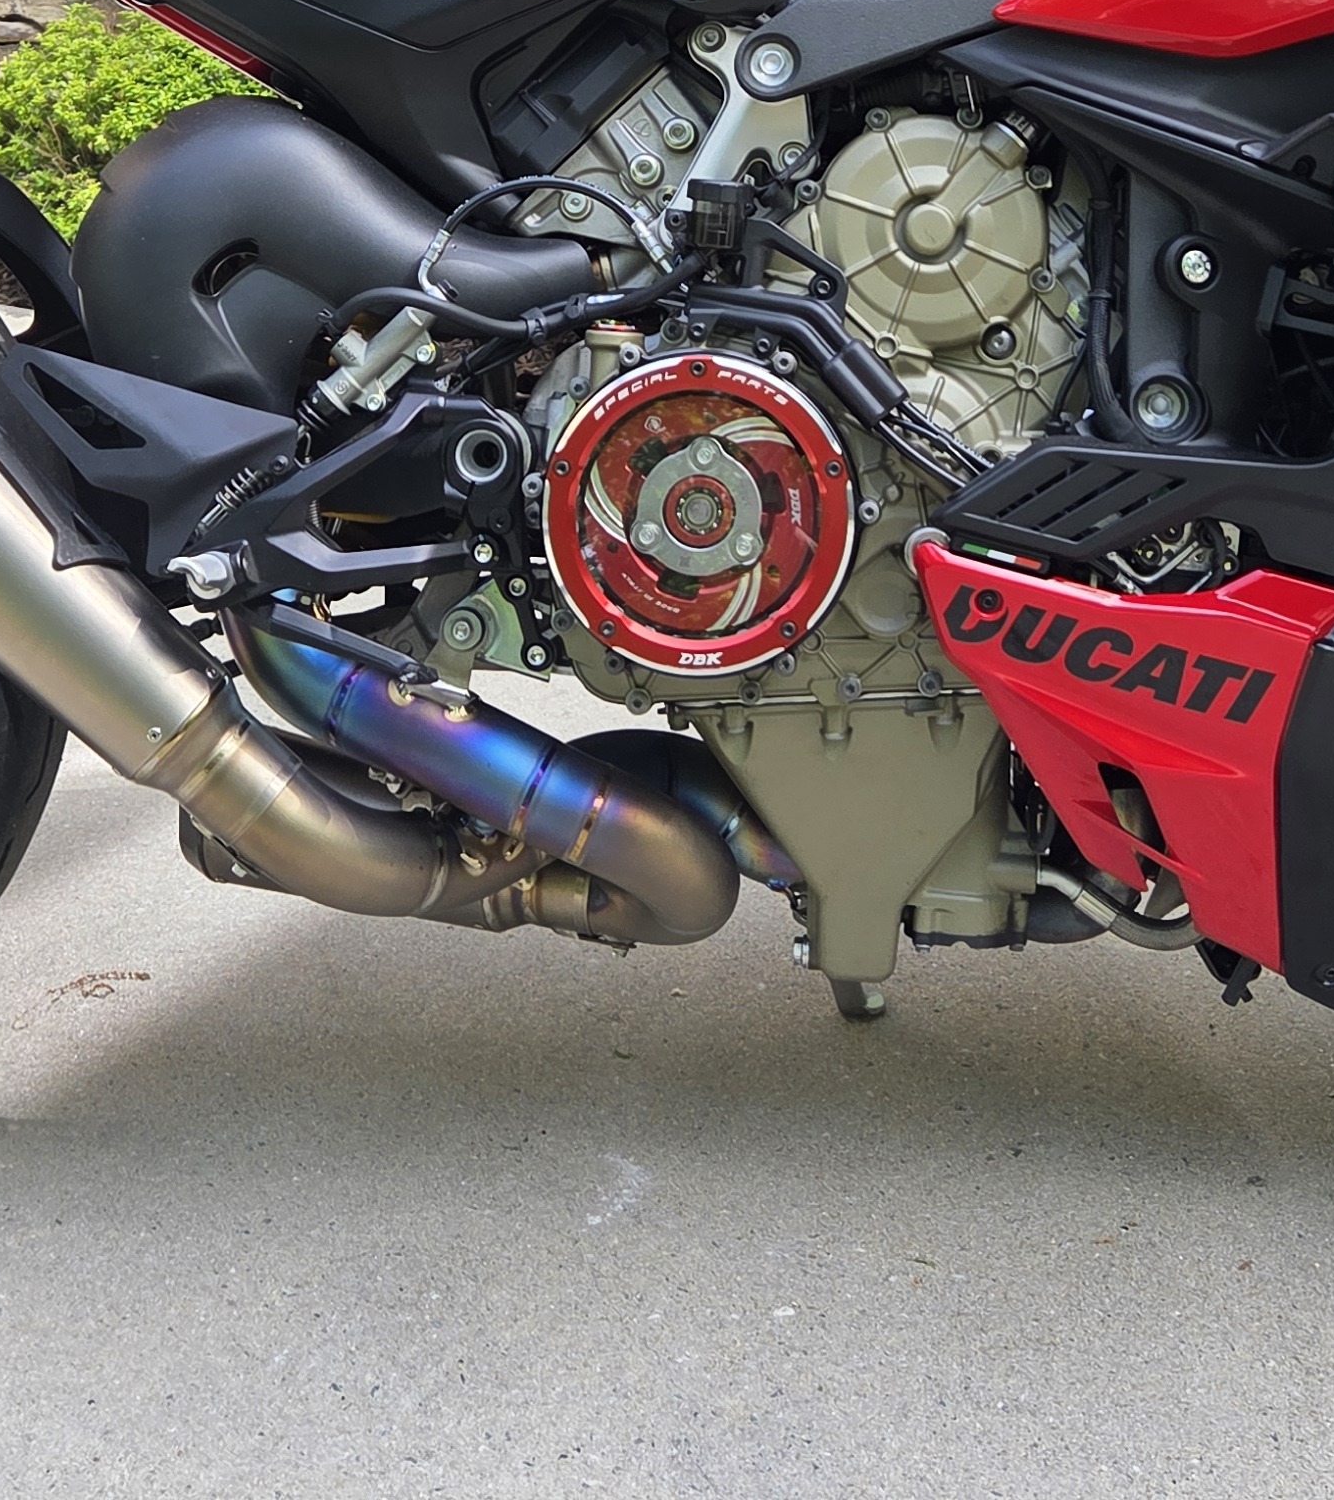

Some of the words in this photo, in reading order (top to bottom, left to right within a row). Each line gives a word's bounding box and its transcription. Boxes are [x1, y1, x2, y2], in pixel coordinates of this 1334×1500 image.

[593, 371, 678, 420] SPECIAL
[717, 370, 789, 405] PARTS
[787, 488, 802, 527] DBK
[677, 651, 723, 666] DBK
[943, 584, 1276, 725] DUCATI
